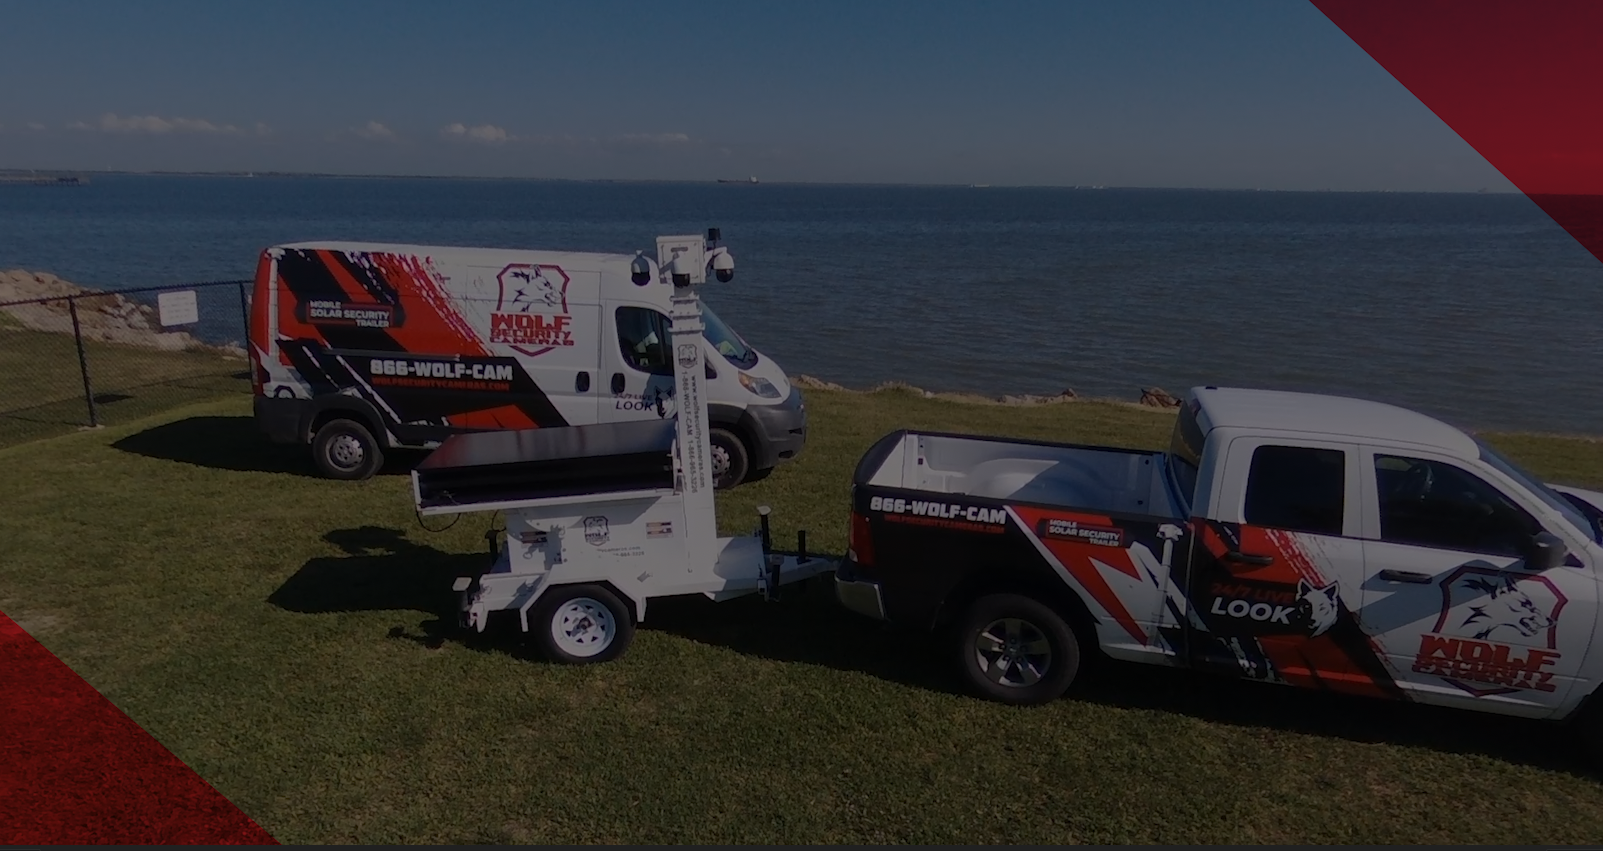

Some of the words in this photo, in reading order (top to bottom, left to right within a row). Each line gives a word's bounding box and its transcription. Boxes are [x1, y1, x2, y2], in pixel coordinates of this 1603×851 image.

[309, 300, 341, 309] MOBILE
[310, 308, 342, 318] SOLAR
[343, 310, 390, 320] SECURITY
[356, 319, 390, 328] TRAILER
[491, 313, 572, 331] WOLF
[491, 328, 571, 340] SECURITY
[370, 358, 513, 381] 866-WOLF-CAM
[616, 400, 653, 412] LOOK
[869, 496, 1007, 525] 866-WOLF-CAM
[1049, 519, 1078, 529] MOBILE
[1048, 525, 1078, 537] SOLAR
[1078, 528, 1120, 541] SECURITY
[1089, 538, 1120, 547] TRAILER
[1210, 596, 1296, 625] LOOK
[1420, 634, 1561, 673] WOLF
